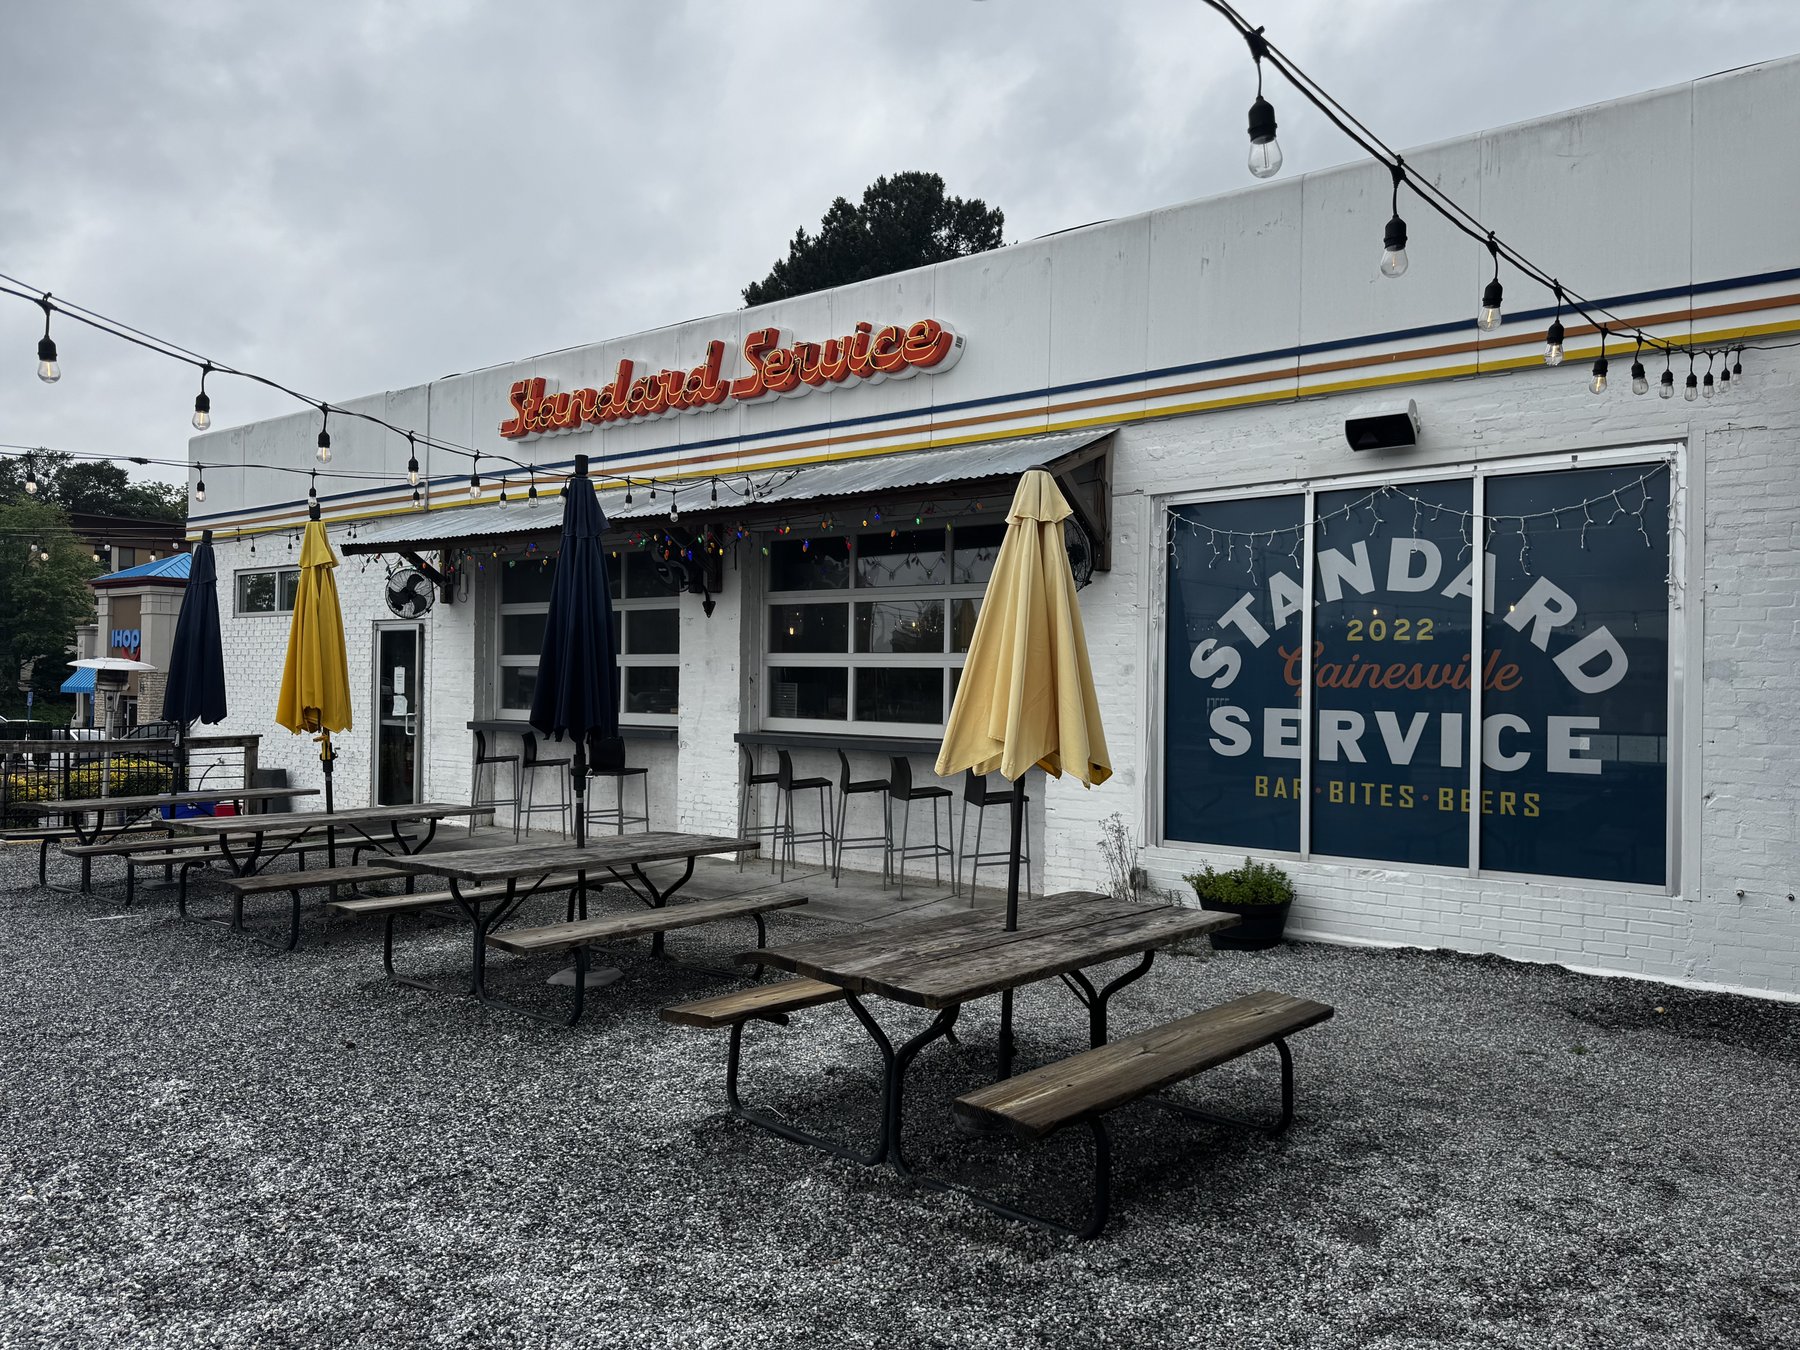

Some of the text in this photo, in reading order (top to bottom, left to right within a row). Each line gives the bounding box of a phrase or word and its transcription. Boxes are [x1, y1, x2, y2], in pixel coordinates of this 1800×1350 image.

[498, 318, 953, 438] Standard Service
[1189, 537, 1629, 694] STANDARD
[1346, 618, 1434, 642] 2022
[1278, 640, 1523, 697] Gainesvile
[1208, 705, 1603, 775] SERVICE
[1329, 780, 1414, 809] BITES
[1438, 787, 1540, 817] BEERS
